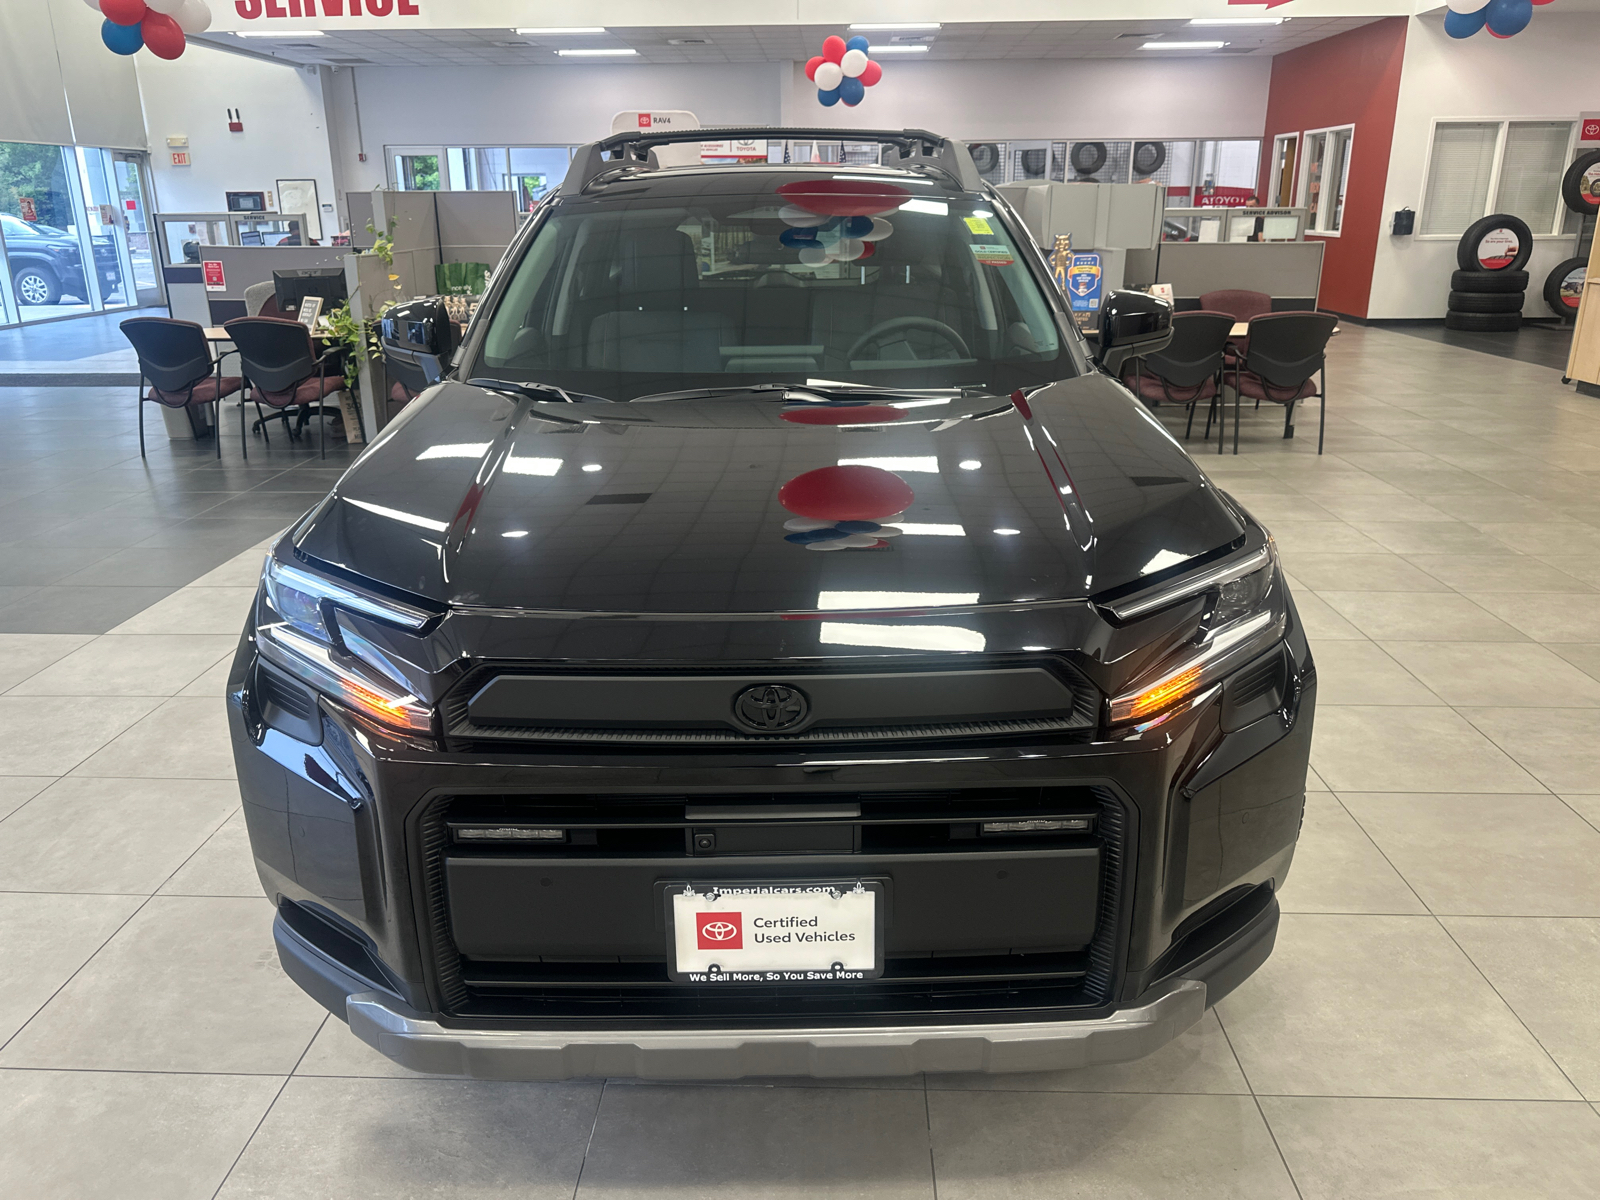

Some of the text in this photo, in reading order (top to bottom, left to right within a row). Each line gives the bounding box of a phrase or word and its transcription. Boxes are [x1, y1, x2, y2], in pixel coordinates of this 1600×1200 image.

[172, 153, 187, 165] EXIT
[712, 886, 836, 895] Imperialcars.com
[753, 916, 818, 928] Certified
[754, 931, 856, 943] Used Vehicles
[689, 971, 864, 982] We Sell More, So You Save More
